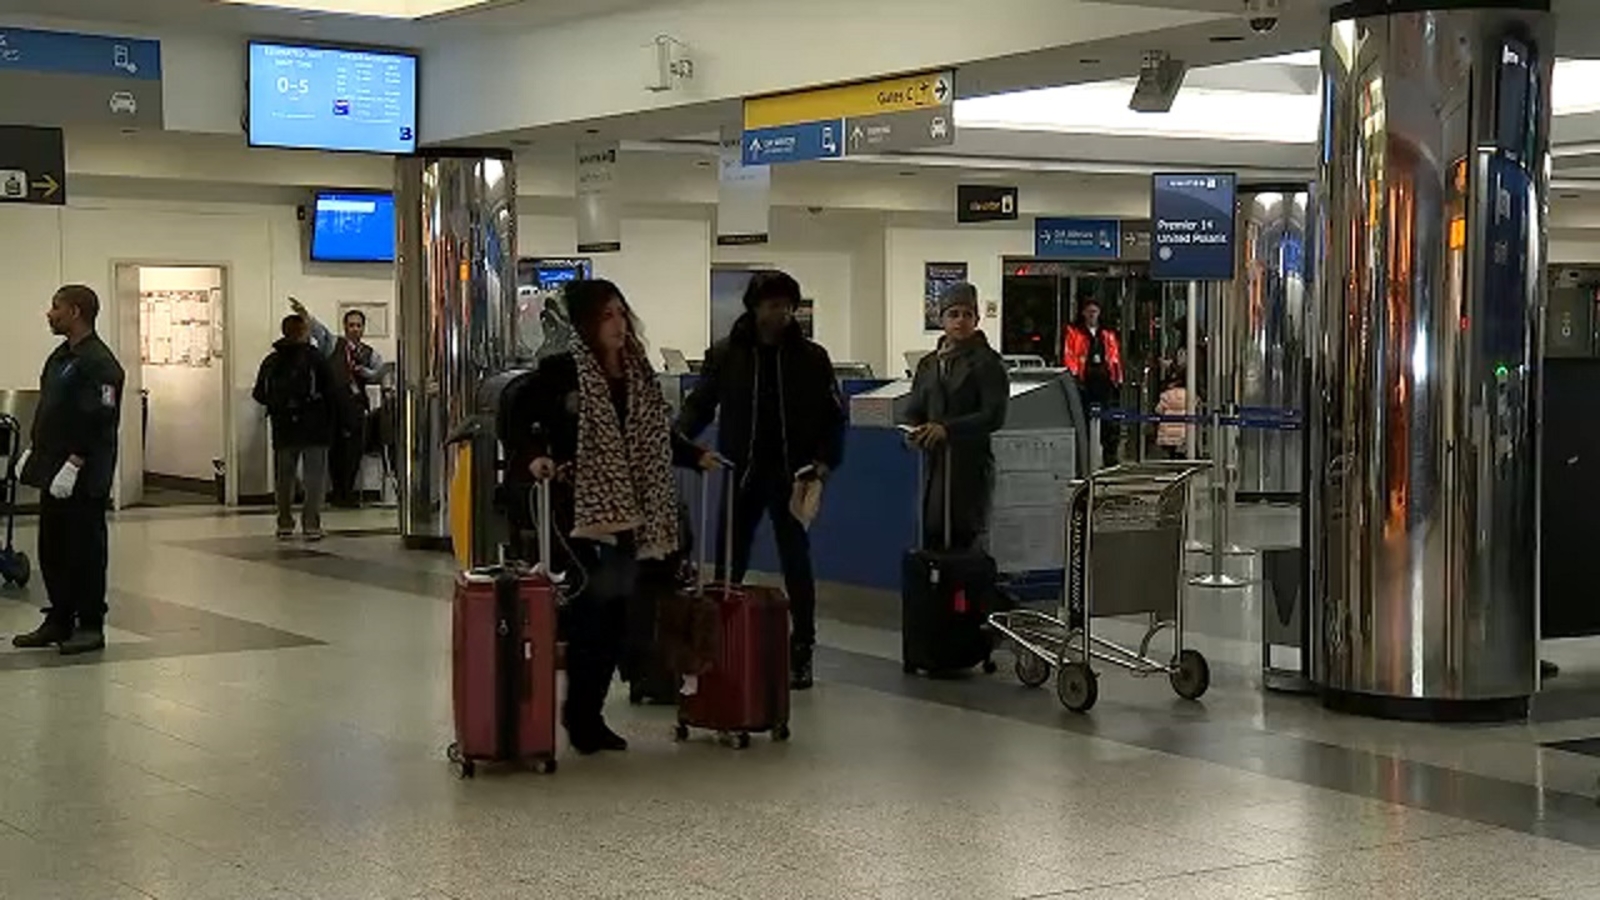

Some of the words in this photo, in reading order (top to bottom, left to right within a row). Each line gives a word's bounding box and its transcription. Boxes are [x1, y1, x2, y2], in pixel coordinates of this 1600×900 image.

[276, 77, 309, 94] 0-5
[877, 91, 903, 105] Gates
[906, 86, 914, 101] C
[1157, 219, 1198, 231] Premier
[1157, 232, 1191, 244] United
